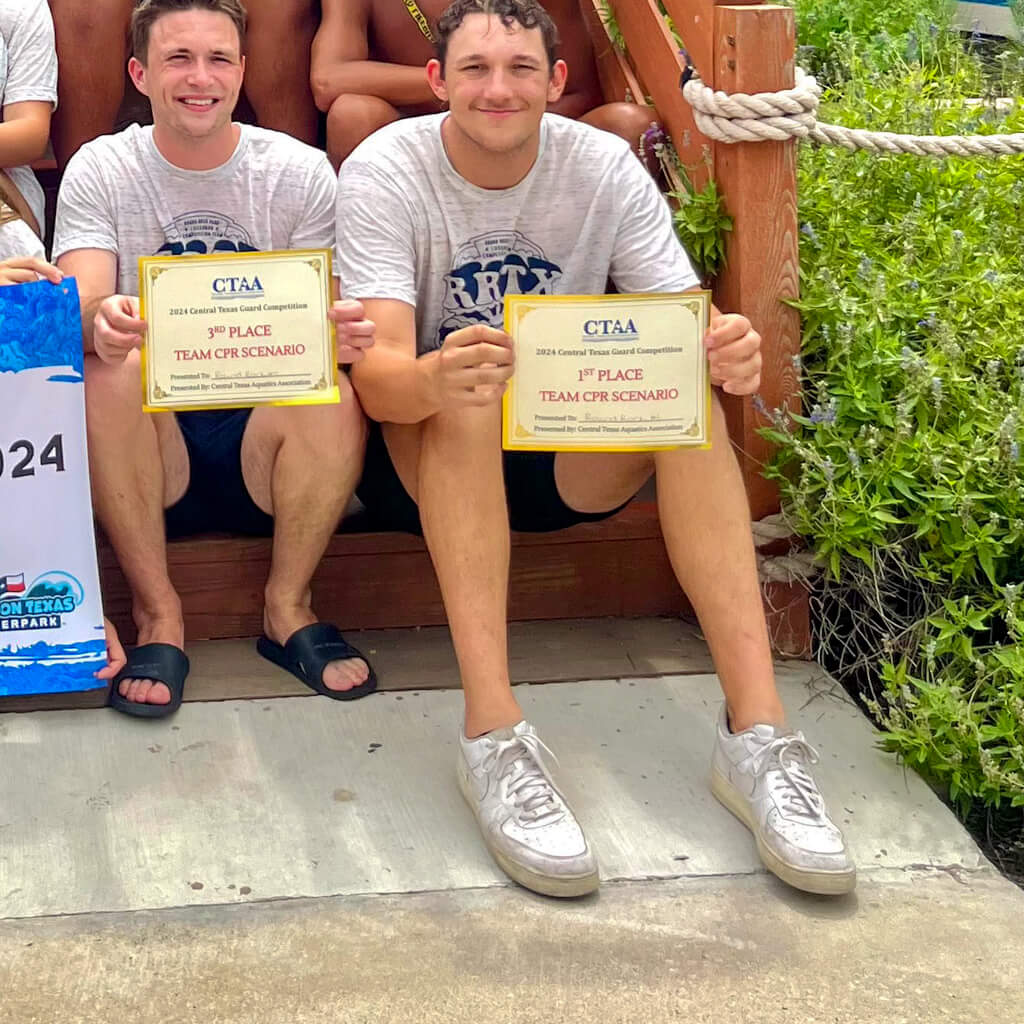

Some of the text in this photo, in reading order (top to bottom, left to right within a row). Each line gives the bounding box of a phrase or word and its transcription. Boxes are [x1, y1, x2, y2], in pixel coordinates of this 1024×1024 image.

[212, 276, 264, 293] CTAA
[169, 302, 308, 316] 2024 Central Texas Guard Competition
[208, 324, 272, 339] 3RD PLACE
[583, 318, 638, 335] CTAA
[174, 343, 306, 361] TEAM CPR SCENARIO
[536, 346, 683, 356] 2024 Central Texas Guard Competition
[578, 368, 643, 382] 1ST PLACE
[539, 388, 679, 402] TEAM CPR SCENARIO
[25, 597, 75, 614] TEXAS
